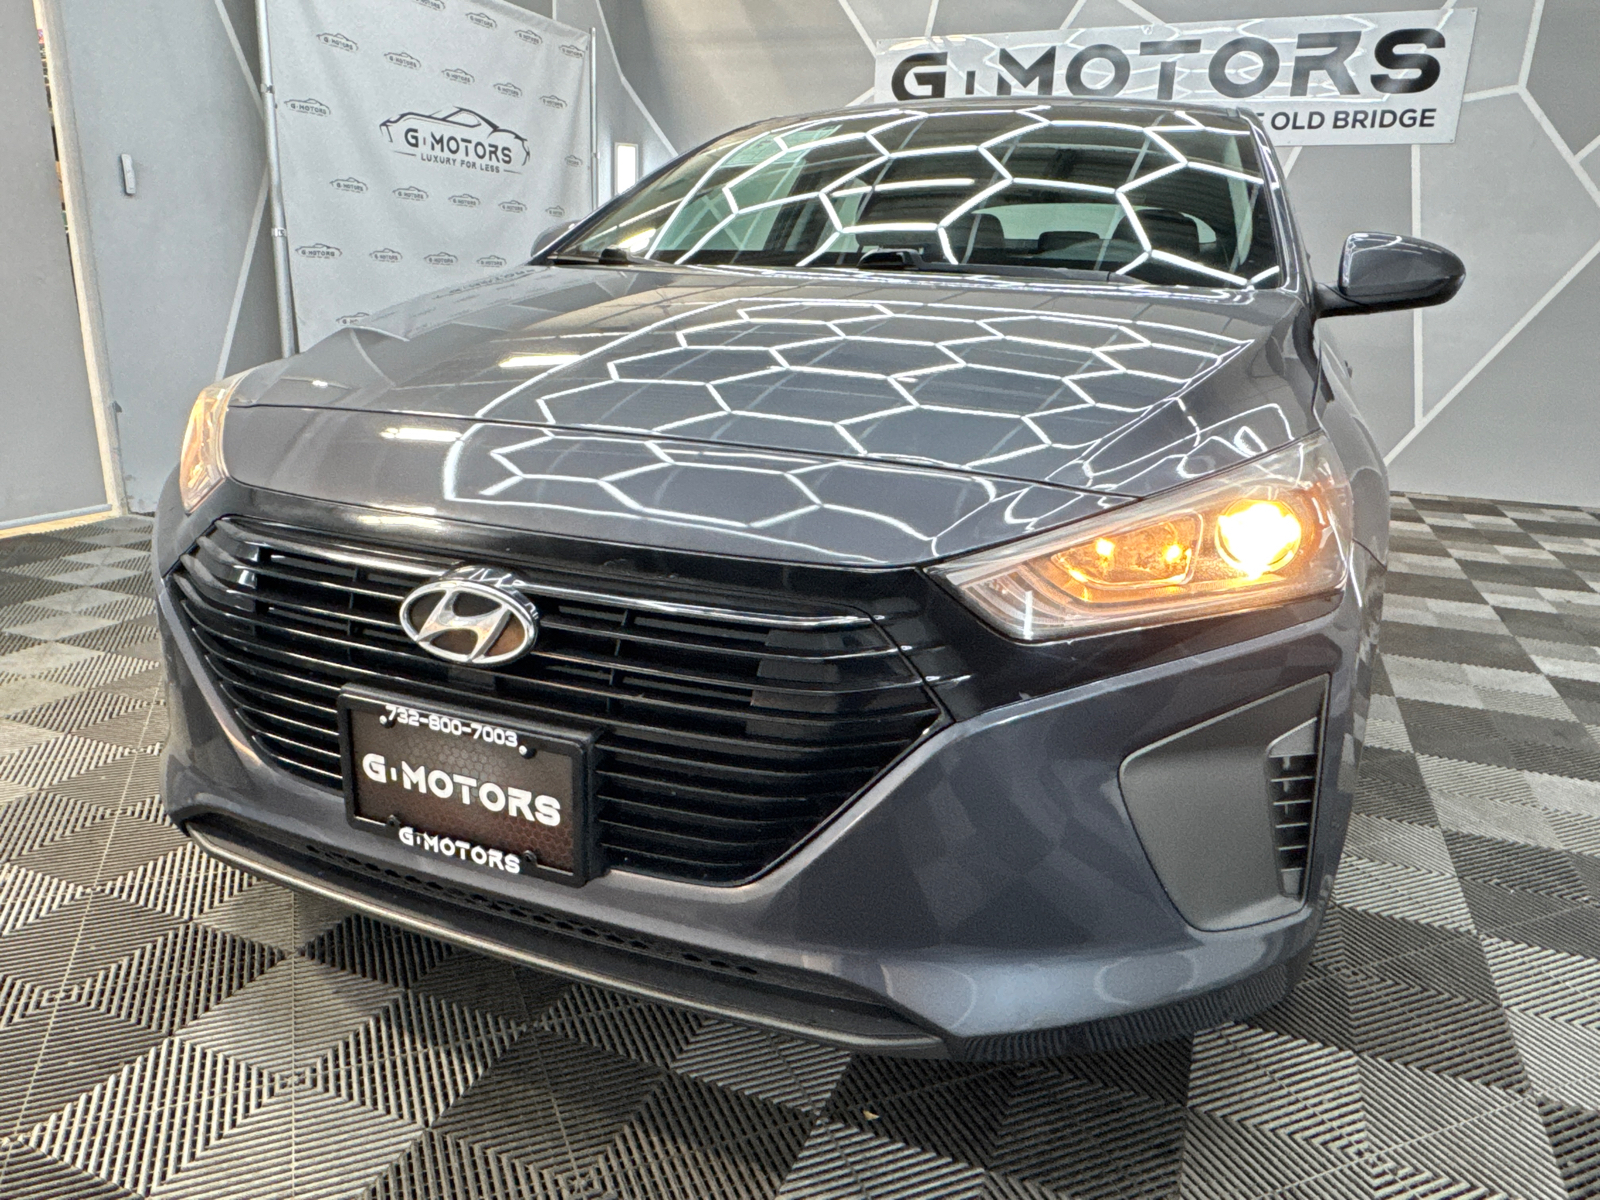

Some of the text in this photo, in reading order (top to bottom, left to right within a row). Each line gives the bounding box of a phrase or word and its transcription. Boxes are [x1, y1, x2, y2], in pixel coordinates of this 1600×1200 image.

[1270, 111, 1325, 130] OLD
[1332, 108, 1437, 129] BRIDGE
[421, 153, 500, 174] LUXURY FOR LESS
[385, 705, 518, 747] 732-800-7003
